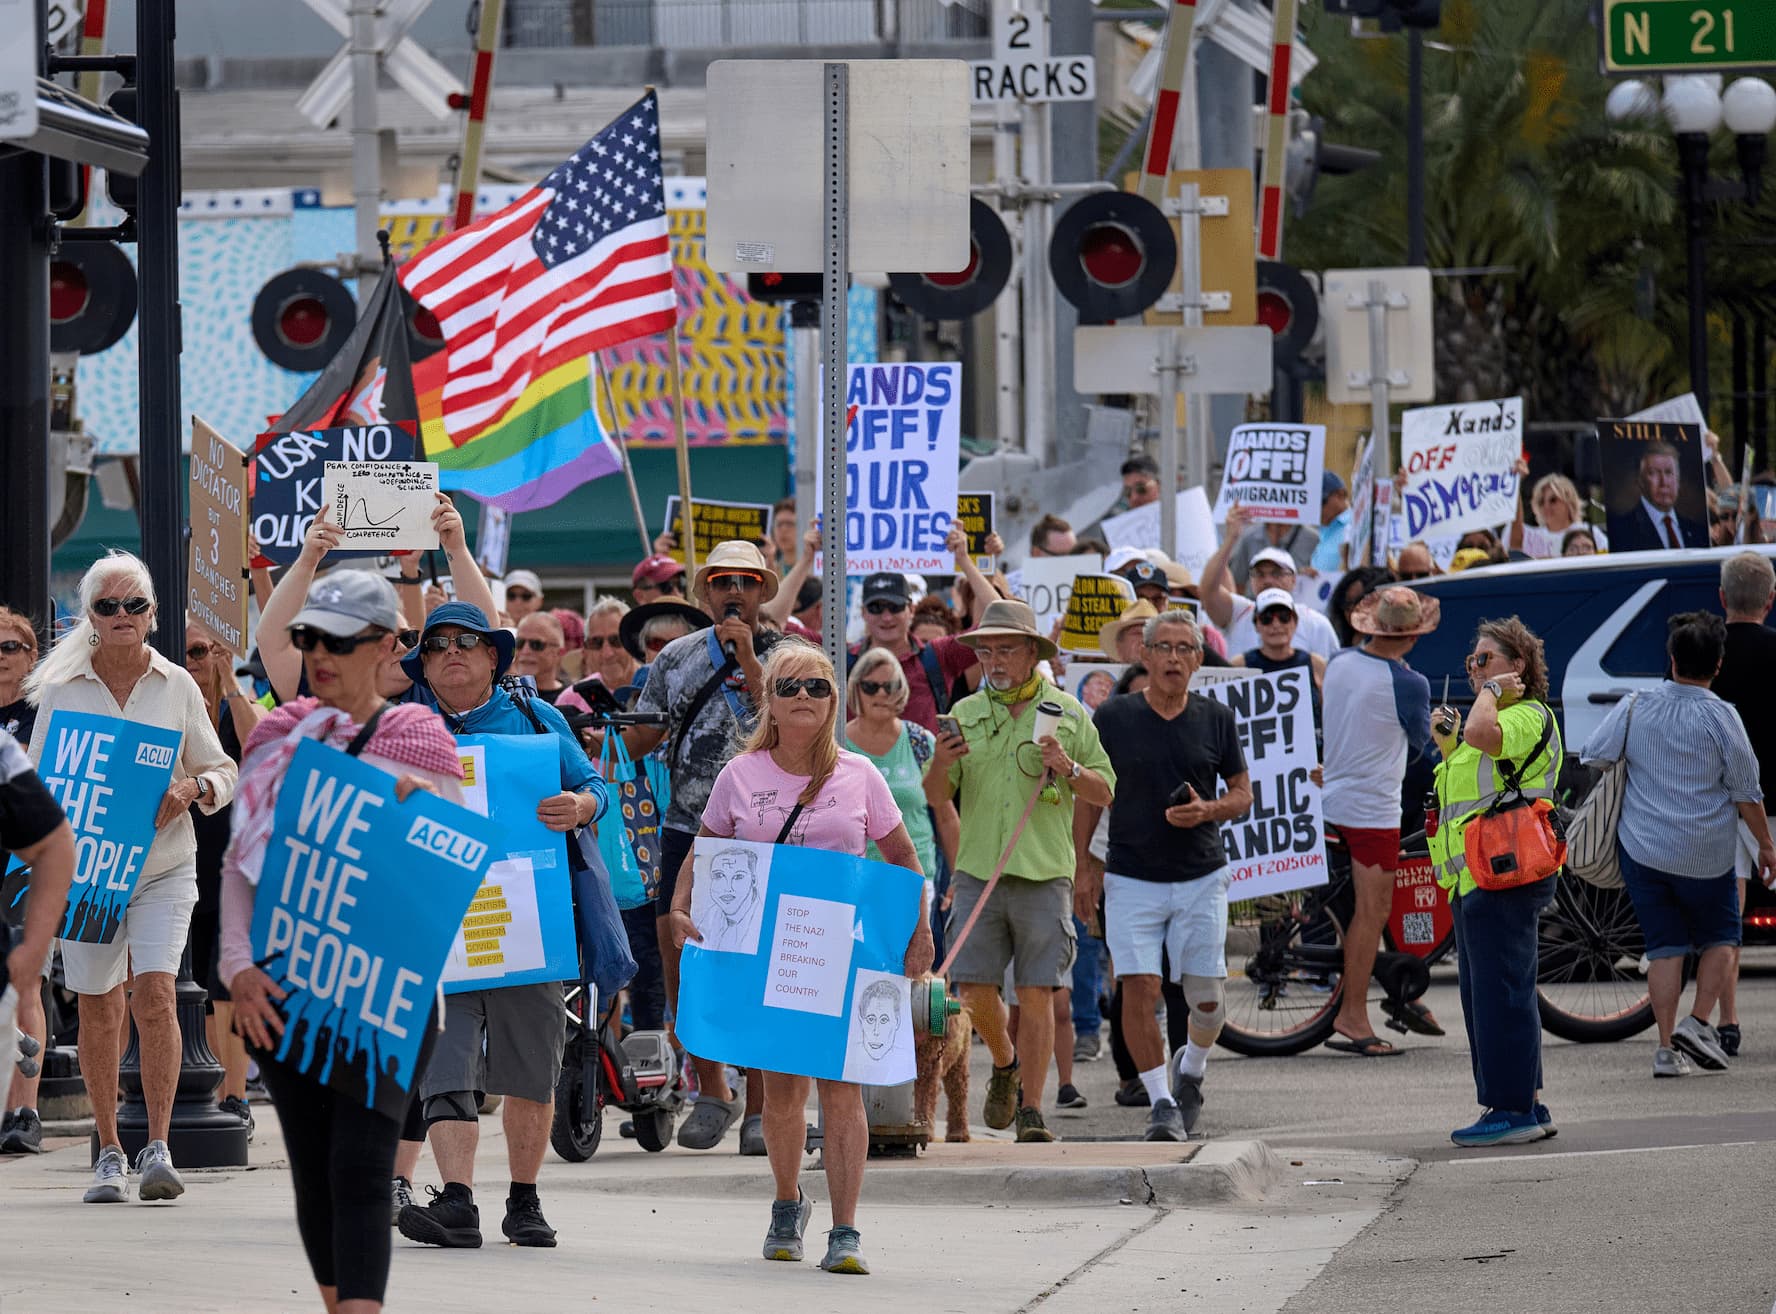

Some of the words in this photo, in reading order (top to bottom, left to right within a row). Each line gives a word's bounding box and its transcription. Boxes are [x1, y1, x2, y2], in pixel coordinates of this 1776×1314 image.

[1008, 14, 1031, 48] 2
[1623, 11, 1650, 56] N
[1689, 9, 1735, 54] 21
[974, 62, 1087, 99] RACKS
[847, 366, 953, 407] ANDS
[209, 436, 225, 470] NO
[257, 431, 329, 479] USA
[342, 425, 393, 462] NO
[1234, 432, 1306, 450] HANDS
[326, 462, 348, 470] PEAK
[351, 462, 401, 471] CONFIDENCE
[352, 470, 371, 478] ZERO
[1231, 451, 1305, 482] OFF!
[1409, 443, 1457, 474] OFF
[192, 453, 241, 517] DICTATOR
[208, 507, 221, 527] BUT
[336, 483, 345, 530] ONFIDENCE
[210, 528, 220, 565] 3
[346, 531, 396, 539] COMPETENCE
[846, 511, 951, 552] ODIES
[195, 546, 237, 602] BRANCHES
[210, 591, 219, 606] OF
[1019, 584, 1073, 615] TOP
[1081, 597, 1111, 613] STEAL
[190, 588, 242, 648] GOVERNMENT
[1209, 672, 1301, 718] NDS
[54, 727, 116, 782] WE
[1237, 714, 1294, 761] FF!
[138, 745, 171, 766] ACLU
[45, 776, 114, 835] THE
[297, 768, 385, 860] WE
[411, 823, 482, 865] ACLU
[1220, 813, 1317, 862] ANDS
[73, 833, 144, 892] OPLE
[1395, 866, 1433, 878] OLLYW
[280, 835, 368, 935] THE
[1396, 875, 1432, 888] BEACH
[463, 917, 484, 927] WHO
[785, 923, 801, 933] THE
[803, 925, 825, 936] NAZI
[786, 907, 810, 918] STOP
[780, 952, 826, 967] BREAKING
[782, 938, 808, 949] FROM
[264, 906, 423, 1039] PEOPLE
[777, 968, 798, 979] OUR
[775, 983, 820, 997] COUNTRY
